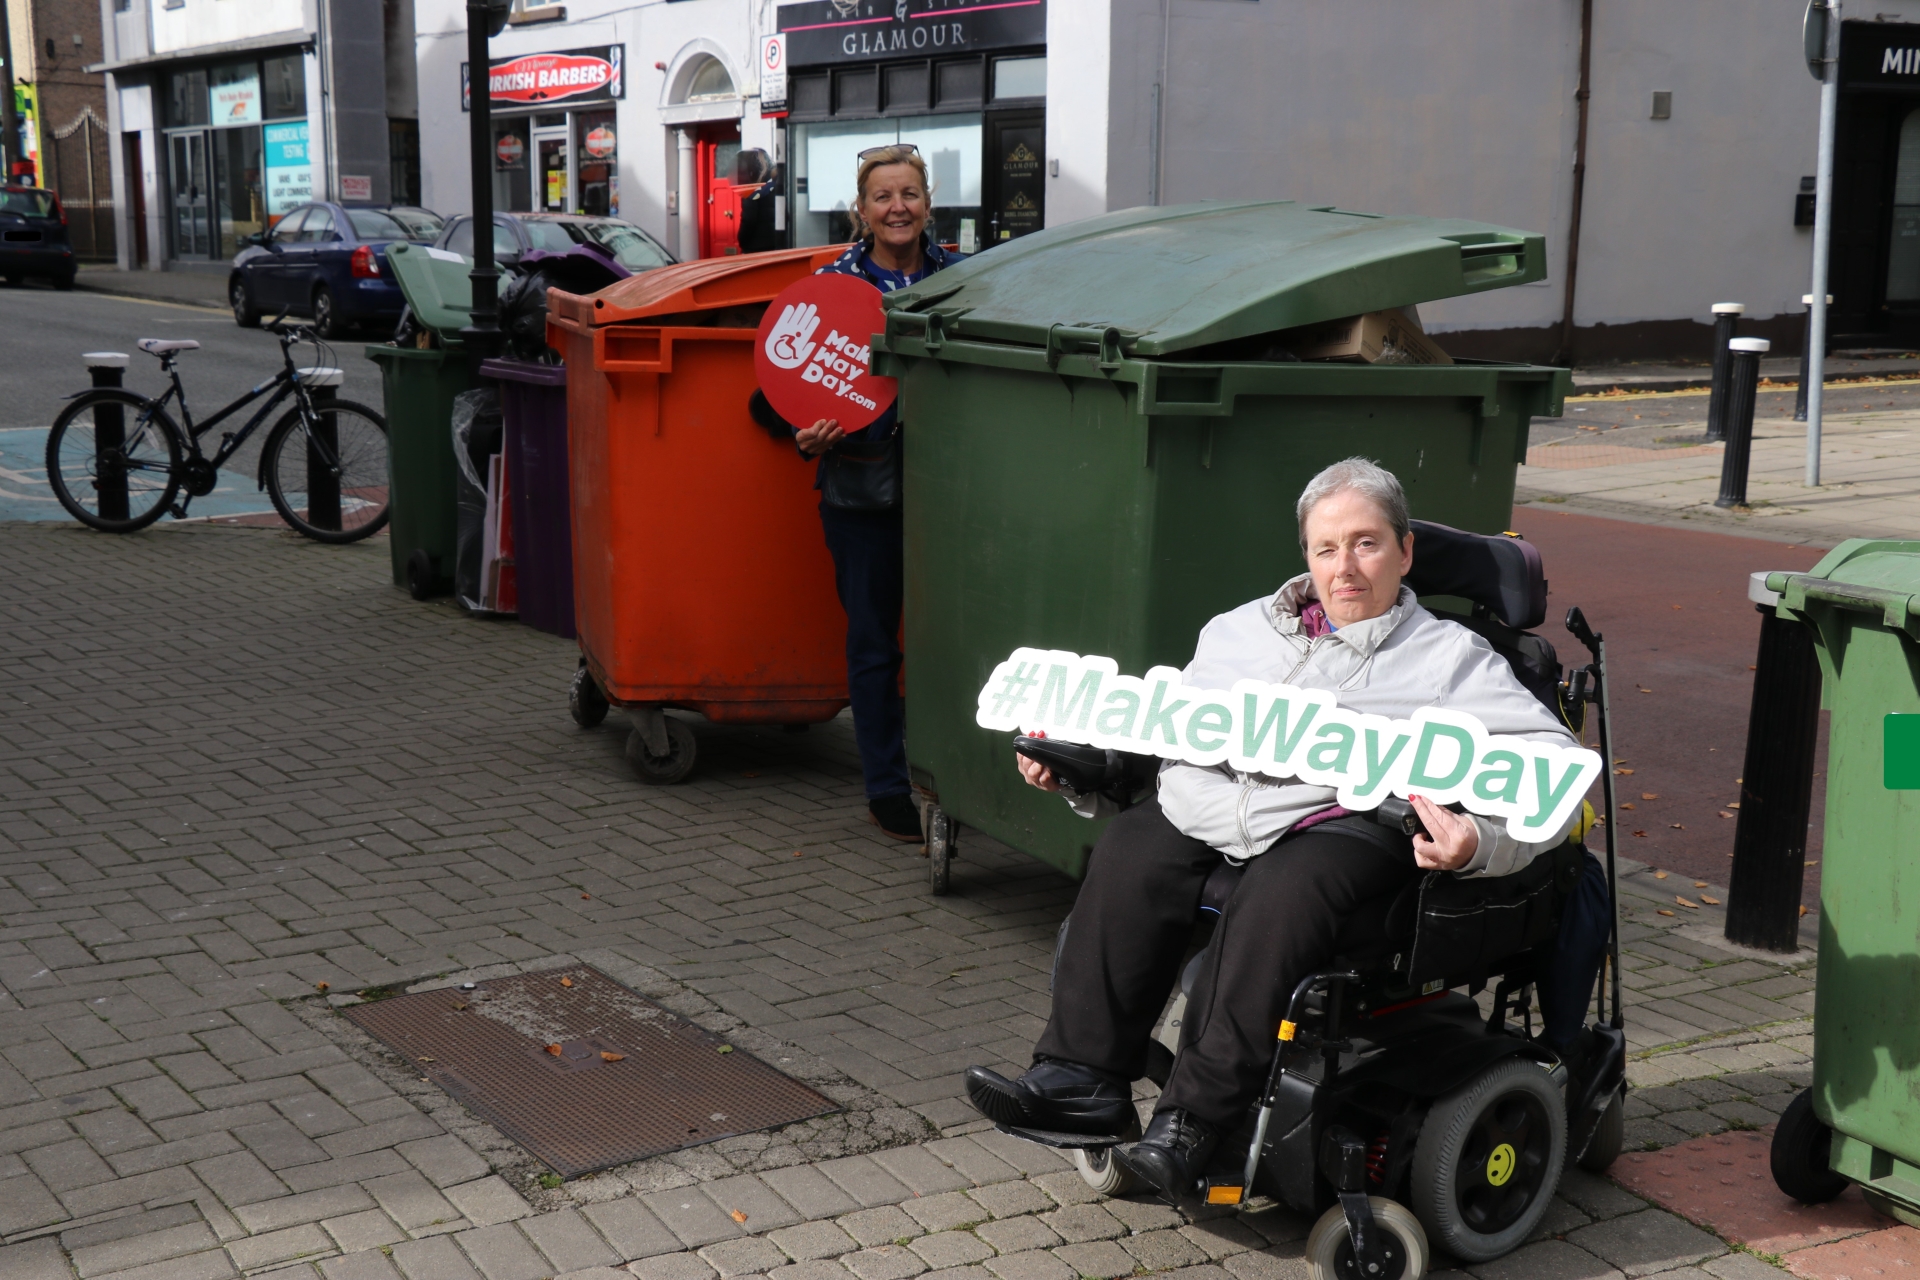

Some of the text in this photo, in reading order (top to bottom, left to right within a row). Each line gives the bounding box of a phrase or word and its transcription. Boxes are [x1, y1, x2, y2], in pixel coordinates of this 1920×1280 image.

[826, 6, 874, 20] HAIR
[842, 23, 965, 55] GLAMOUR
[489, 64, 607, 92] RKISH BARBERS
[1003, 161, 1039, 170] GLAMOUR
[286, 187, 312, 197] COMMERC
[824, 329, 870, 365] Mak
[812, 346, 865, 381] Way
[801, 362, 877, 411] Day.com
[991, 660, 1584, 829] #MakeWayDay
